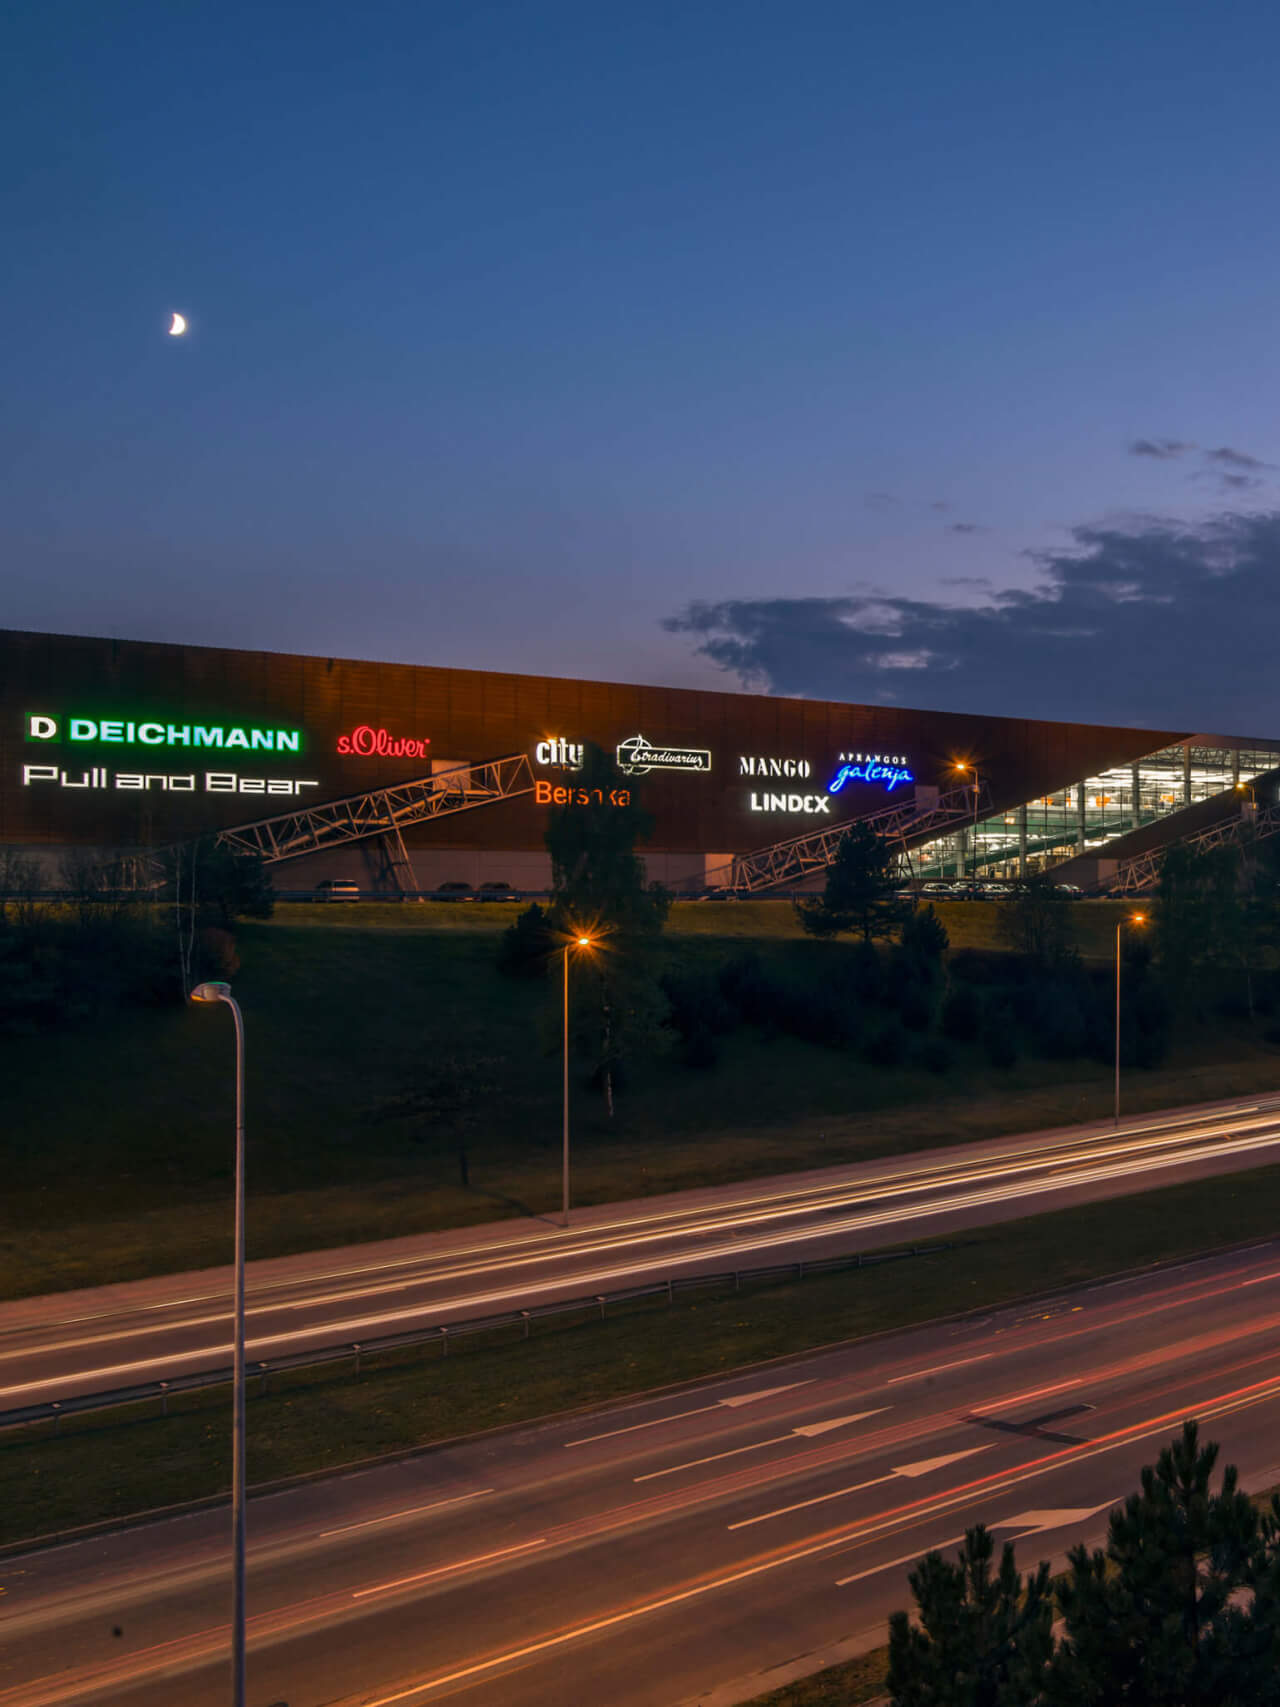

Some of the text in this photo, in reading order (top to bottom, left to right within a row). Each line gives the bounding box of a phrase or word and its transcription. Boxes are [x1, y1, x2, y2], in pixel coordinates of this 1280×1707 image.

[70, 718, 301, 752] DEICHMANN
[337, 725, 427, 758] s.Oliver
[536, 738, 584, 771] city
[739, 756, 811, 779] MANGO
[839, 752, 907, 765] APRANGOS
[22, 765, 319, 794] Pull and Bear
[751, 792, 829, 813] LINDEX
